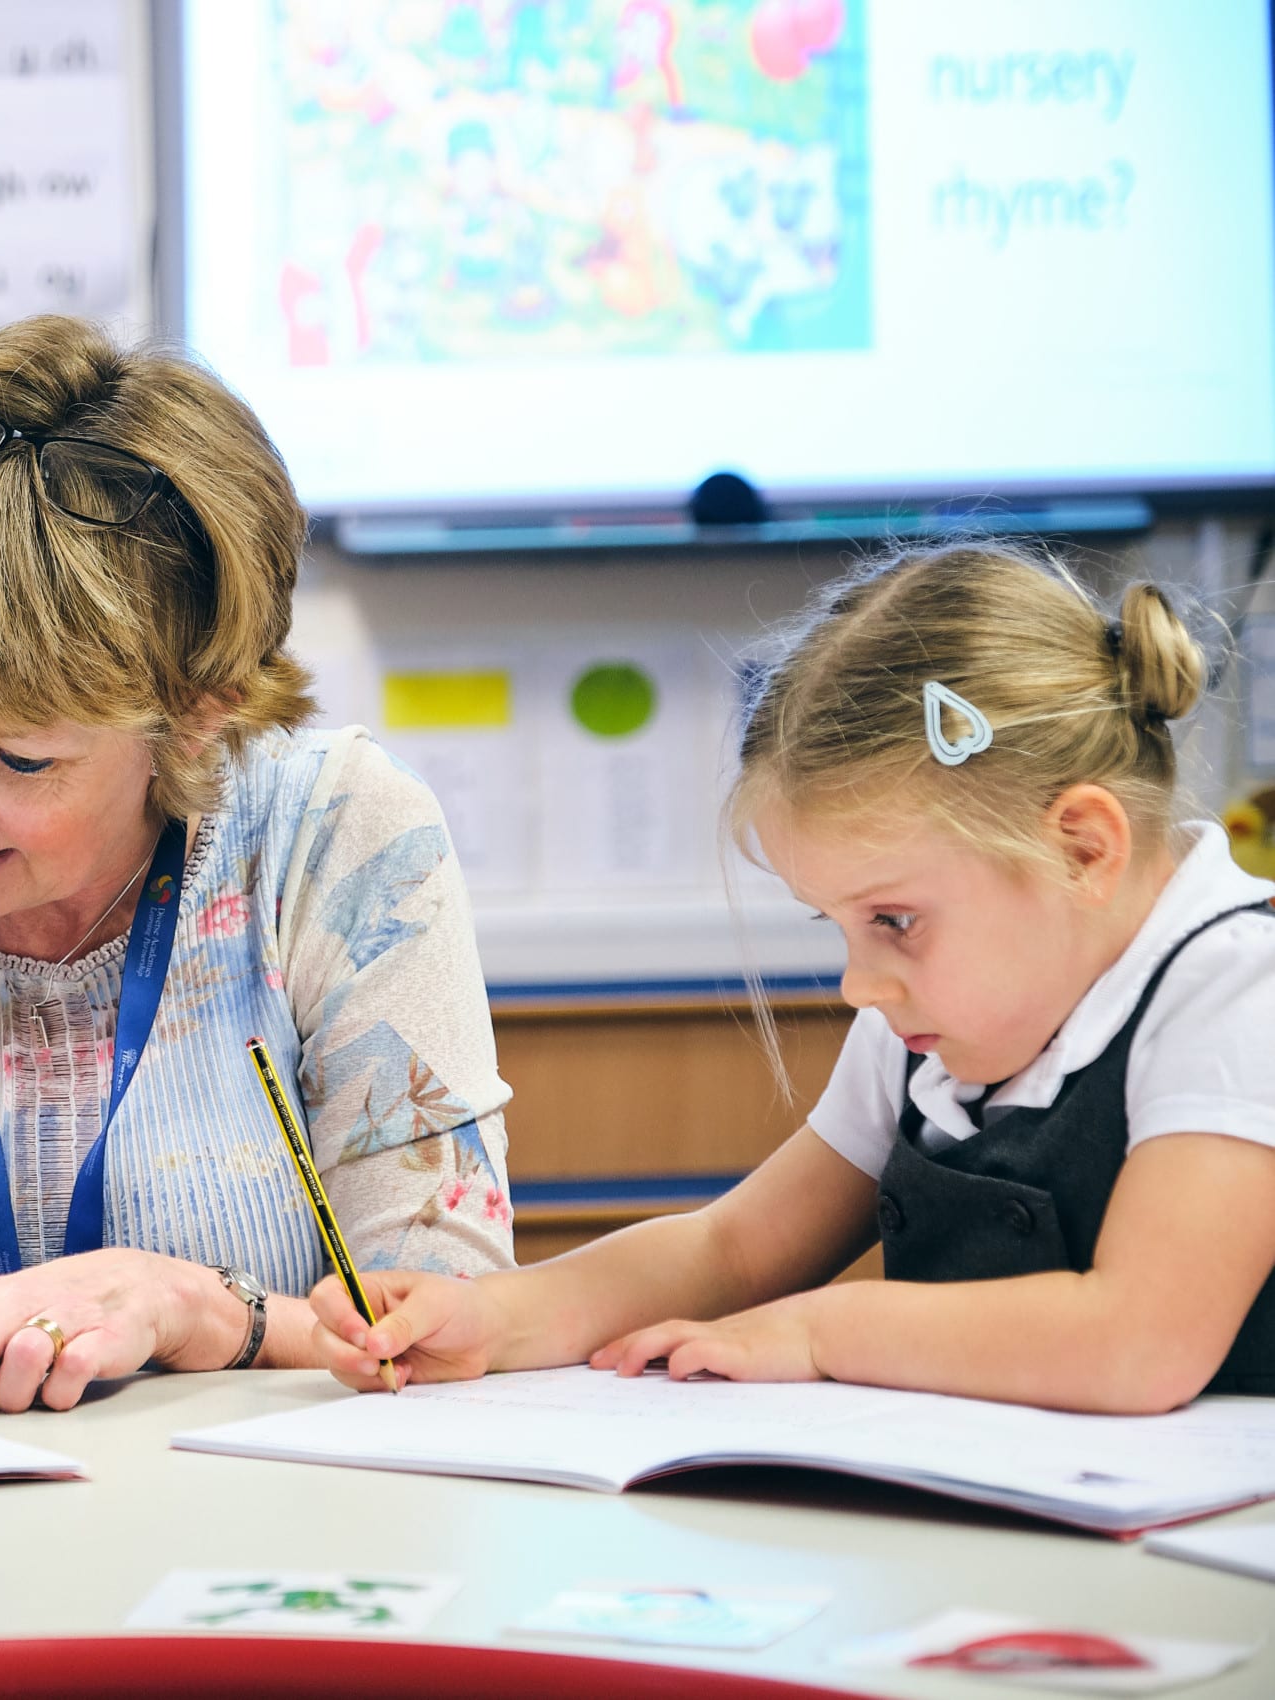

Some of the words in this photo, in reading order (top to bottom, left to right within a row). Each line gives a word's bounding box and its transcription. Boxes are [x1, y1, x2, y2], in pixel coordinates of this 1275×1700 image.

[931, 50, 1136, 123] nursery
[932, 158, 1136, 251] rhyme?
[153, 907, 166, 936] Diverse
[144, 938, 160, 978] Academies
